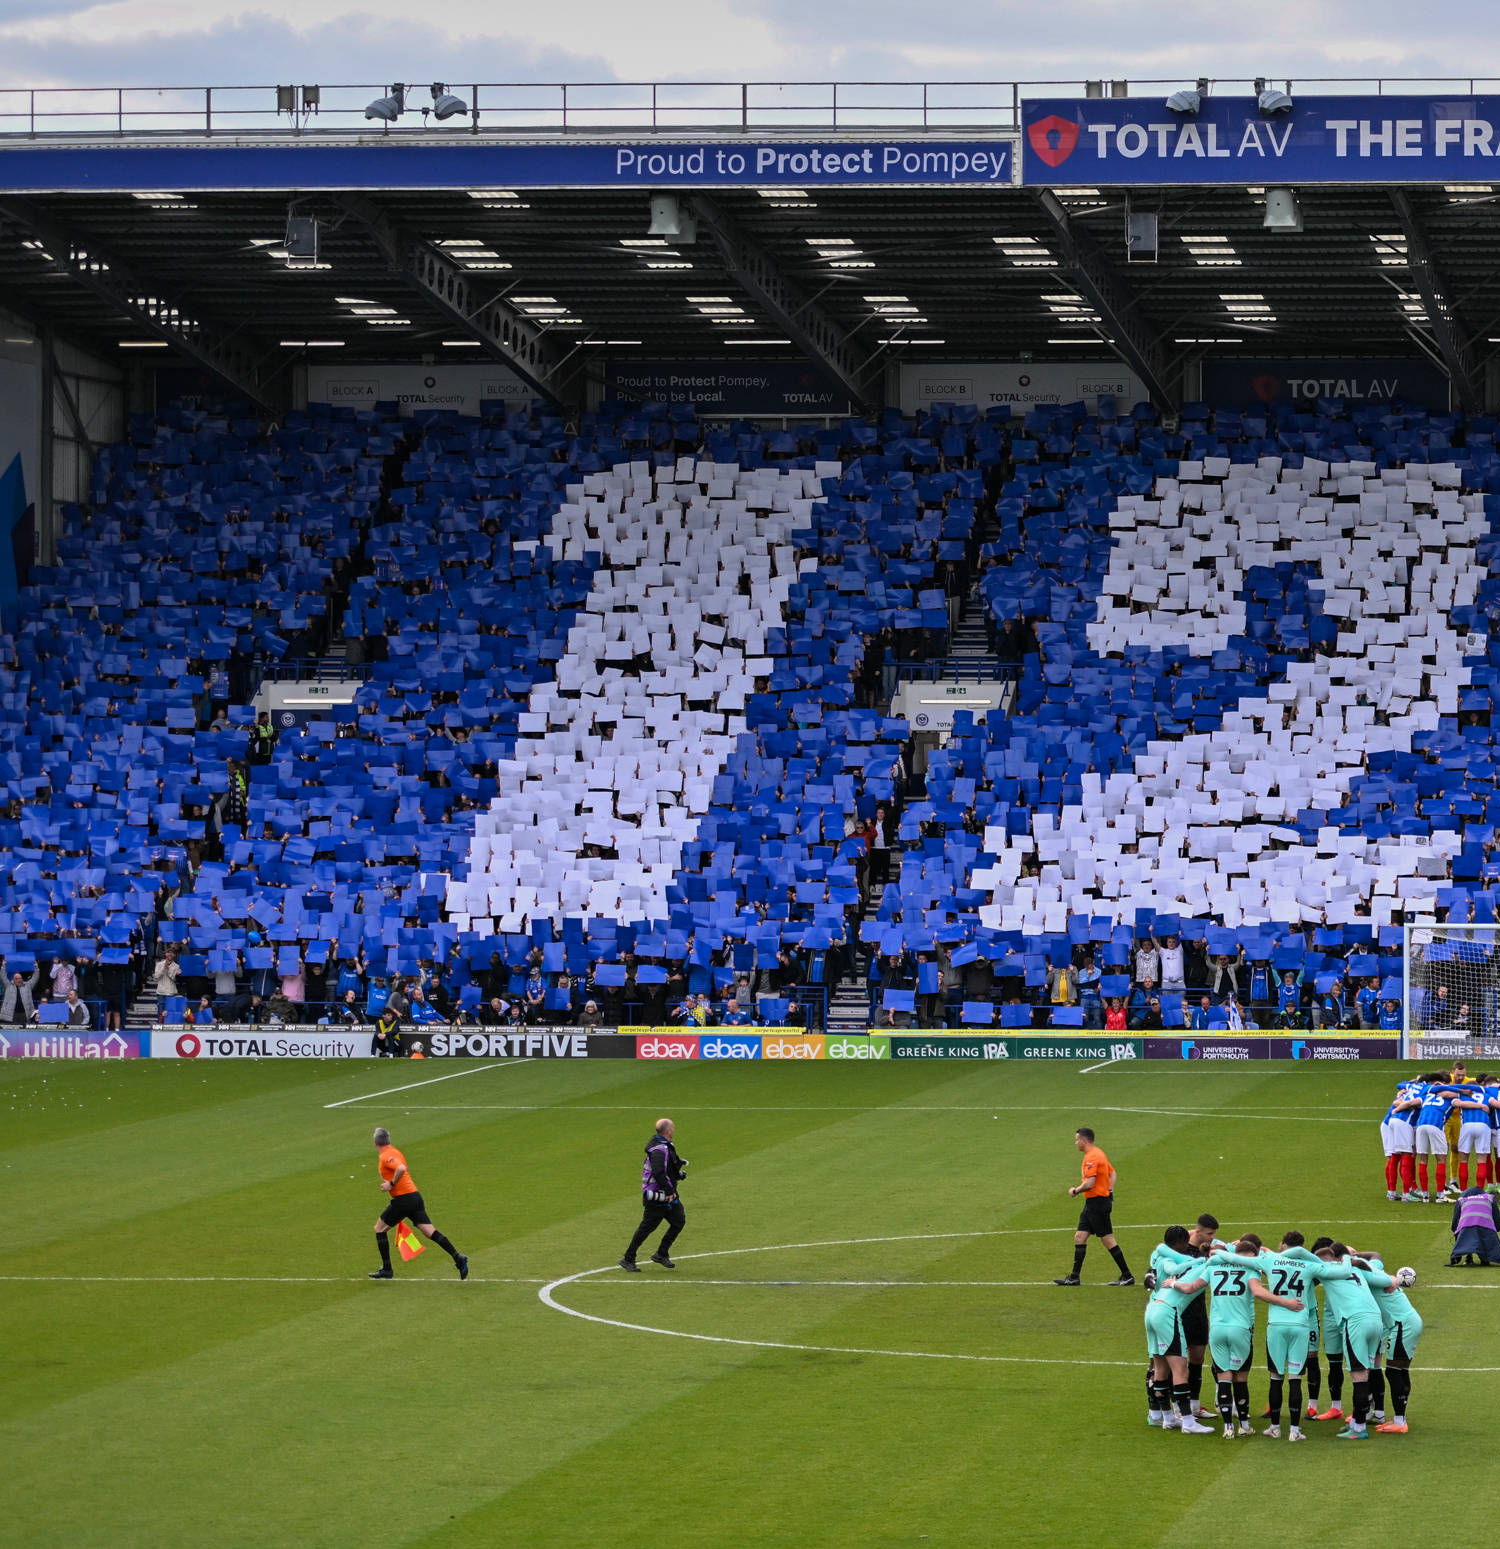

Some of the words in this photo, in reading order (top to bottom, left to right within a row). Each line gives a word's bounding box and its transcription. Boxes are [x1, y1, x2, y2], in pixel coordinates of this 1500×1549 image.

[1088, 123, 1230, 159] TOTAL
[1237, 123, 1294, 158] AV
[1326, 119, 1422, 158] THE
[616, 147, 704, 174] Proud
[715, 149, 745, 174] to
[756, 148, 873, 174] Protect
[882, 147, 1007, 178] Pompey
[487, 384, 518, 394] BLOCK
[616, 375, 651, 386] Proud
[655, 376, 667, 386] to
[670, 375, 716, 386] Protect
[925, 384, 957, 394] BLOCK
[959, 384, 966, 393] B
[1082, 383, 1115, 393] BLOCK
[1287, 379, 1364, 399] TOTAL
[1367, 379, 1399, 398] AV
[332, 386, 363, 396] BLOCK
[366, 386, 374, 395] A
[655, 392, 667, 401] to
[671, 391, 686, 401] be
[783, 393, 817, 403] TOTAL
[989, 393, 1021, 402] TOTAL
[24, 1037, 100, 1058] utilita
[205, 1039, 272, 1056] TOTAL
[276, 1039, 355, 1058] Security
[431, 1034, 588, 1057] SPORTFIVE
[640, 1038, 696, 1059] ebay
[703, 1038, 759, 1059] ebay
[765, 1039, 821, 1060] ebay
[829, 1039, 886, 1060] ebay
[897, 1047, 944, 1057] GREENE
[949, 1047, 979, 1057] KING
[983, 1043, 1009, 1059] IPA
[1024, 1048, 1071, 1058] GREENE
[1075, 1048, 1106, 1058] KING
[1110, 1043, 1136, 1060] IPA
[1424, 1045, 1473, 1055] HUGHES
[1273, 1259, 1306, 1269] CHAMBERS
[1213, 1270, 1247, 1297] 23
[1271, 1269, 1305, 1298] 24
[1309, 1330, 1317, 1342] 8
